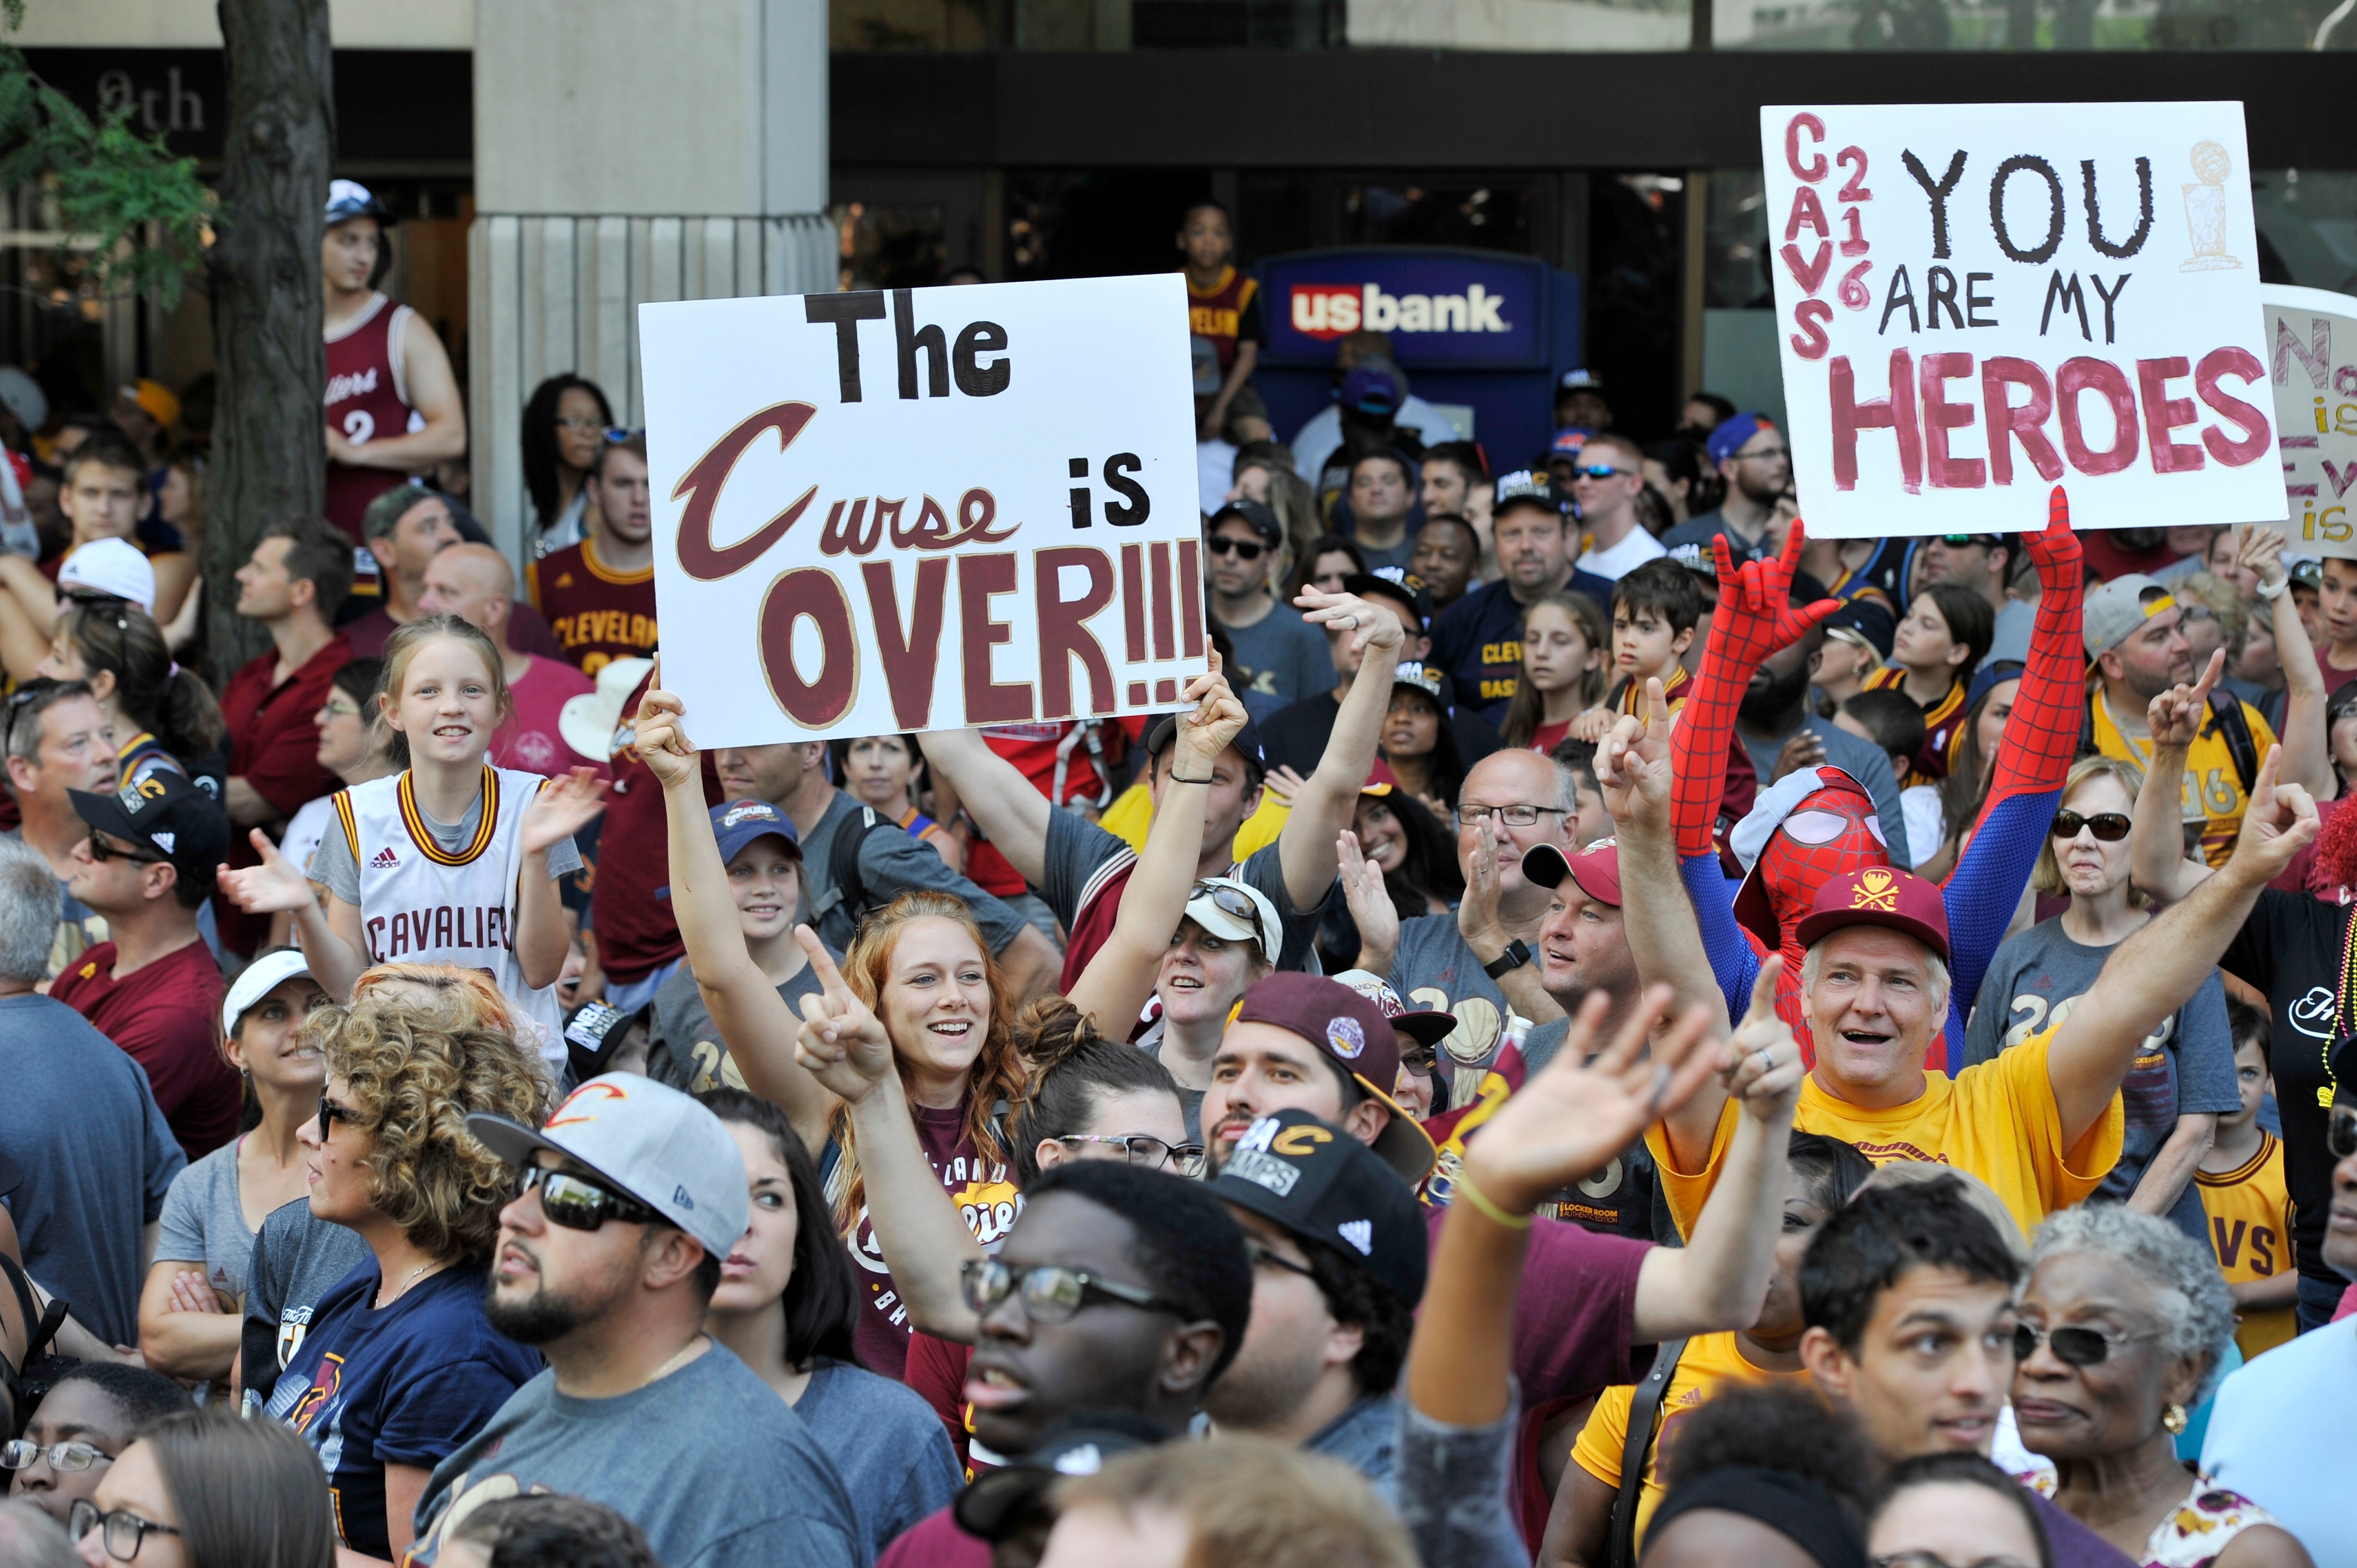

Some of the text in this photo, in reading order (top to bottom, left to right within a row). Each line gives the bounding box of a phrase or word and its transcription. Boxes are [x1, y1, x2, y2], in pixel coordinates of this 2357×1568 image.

[1779, 111, 1834, 362] CAVS
[1836, 145, 1873, 311] 216
[1901, 147, 2155, 265] YOU
[1878, 264, 2133, 345] ARE MY
[804, 289, 1011, 403] The
[1828, 346, 2272, 496] HEROES
[671, 400, 1150, 582] Curse is
[2303, 499, 2353, 541] is
[757, 538, 1206, 731] OVER!!!
[1480, 678, 1519, 699] BAS
[369, 860, 402, 869] adidas
[570, 1003, 609, 1033] NBA
[1563, 1210, 1595, 1221] AUTHENTIC
[1564, 1203, 1618, 1218] LOCKER ROOM
[2213, 1216, 2276, 1276] VS
[281, 1308, 299, 1322] The
